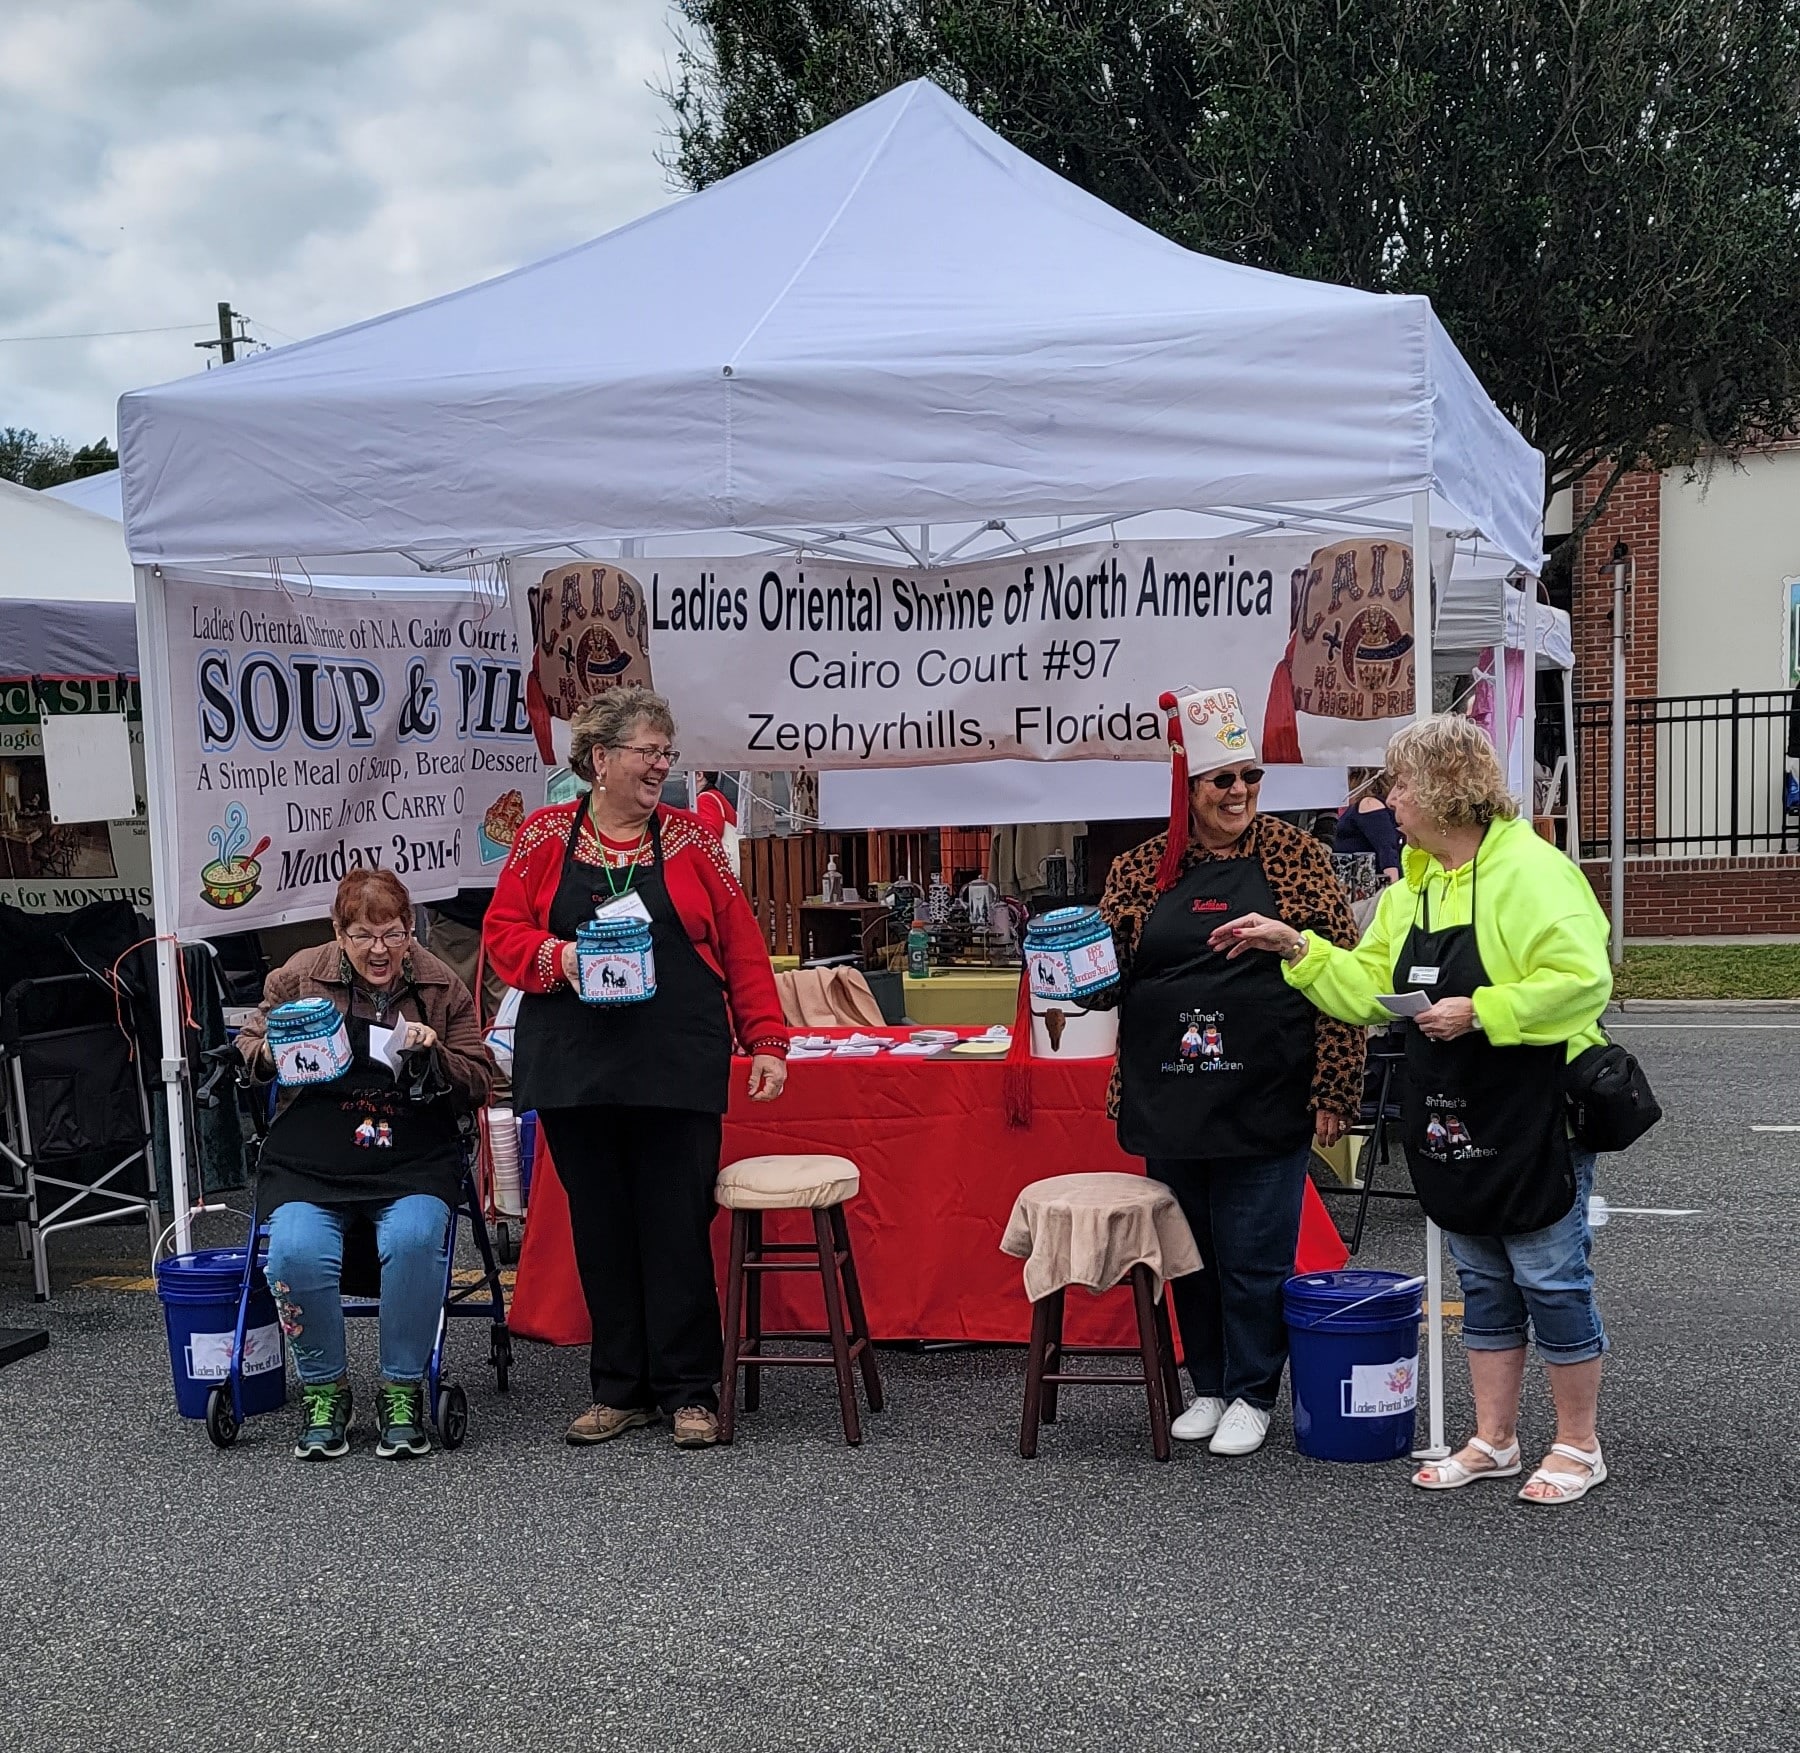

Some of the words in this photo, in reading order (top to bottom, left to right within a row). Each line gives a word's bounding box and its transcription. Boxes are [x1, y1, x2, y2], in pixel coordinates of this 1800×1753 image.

[651, 571, 747, 631] Ladies
[759, 570, 881, 633] Oriental
[893, 577, 993, 634] Shrine
[1003, 567, 1034, 625] of
[1040, 556, 1127, 622] North
[1135, 554, 1273, 618] America
[239, 610, 308, 645] Oriental
[306, 615, 347, 649] Shrine
[349, 619, 366, 650] of
[368, 619, 405, 649] N.A.
[408, 618, 451, 648] Cairo
[789, 649, 900, 690] Cairo
[917, 640, 1028, 685] Court
[1042, 638, 1121, 681] #97
[200, 655, 382, 747] SOUP
[399, 662, 437, 736] &
[0, 730, 40, 751] agic
[747, 709, 996, 760] Zephyrhills,
[1014, 703, 1161, 747] Florida
[197, 763, 213, 790] A
[219, 760, 288, 795] Simple
[294, 758, 340, 786] Meal
[349, 757, 367, 784] of
[367, 757, 408, 784] Soup,
[472, 748, 538, 773] Dessert
[277, 839, 383, 892] Monday
[17, 887, 46, 907] for
[52, 887, 152, 907] MONTHS
[912, 951, 921, 961] G
[1179, 1009, 1225, 1023] Shriner's
[1161, 1059, 1194, 1074] Helping
[1200, 1057, 1244, 1072] Children
